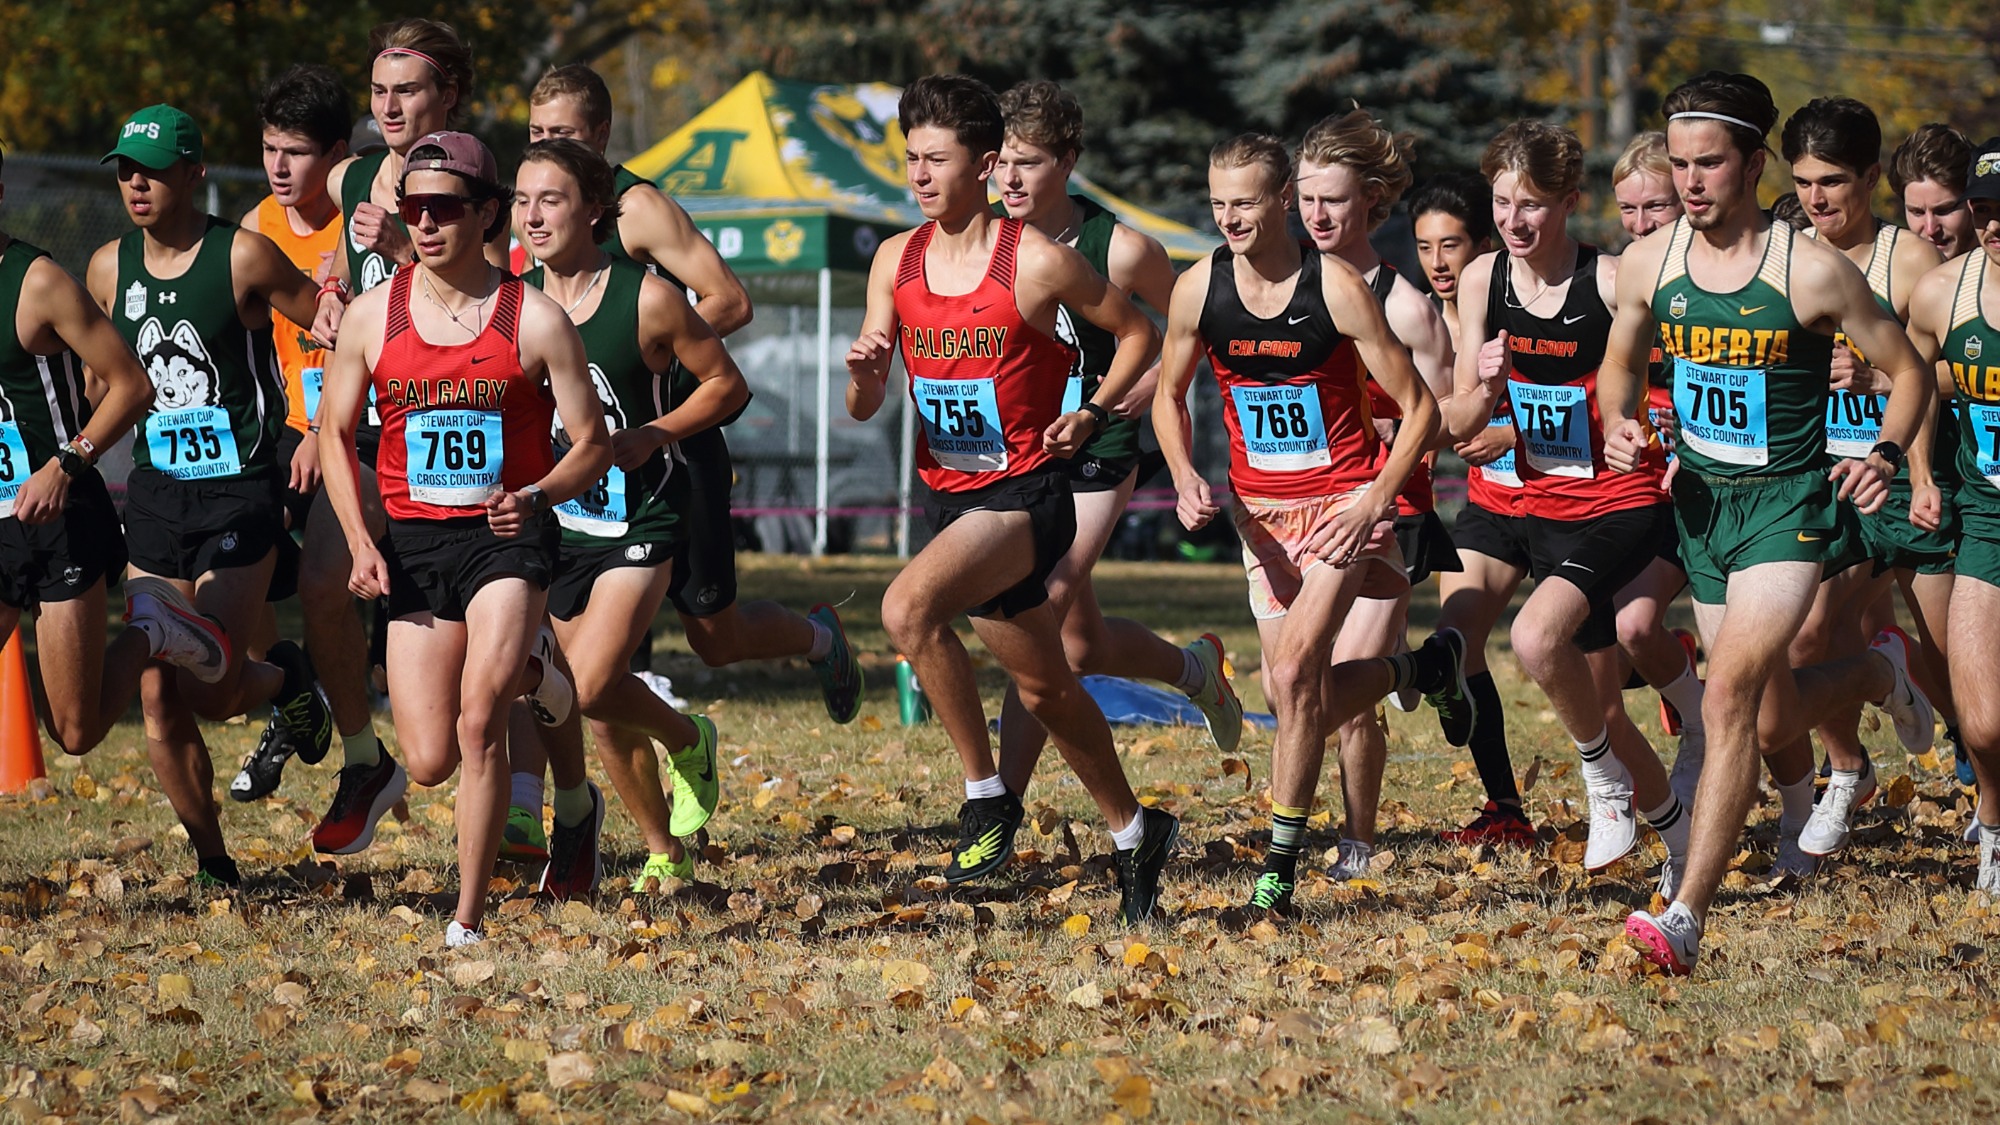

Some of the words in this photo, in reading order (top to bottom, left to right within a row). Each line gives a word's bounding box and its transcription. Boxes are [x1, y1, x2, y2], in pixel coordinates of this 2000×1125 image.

[1229, 339, 1302, 358] CALGARY
[1508, 335, 1578, 357] CALGARY
[1660, 322, 1789, 366] ALBERTA
[1686, 366, 1727, 385] STEWART
[1729, 374, 1749, 387] CUP
[387, 378, 508, 409] CALGARY
[922, 383, 959, 397] STEWART
[961, 384, 979, 396] CUP
[1243, 389, 1283, 402] STEWART
[1285, 388, 1303, 400] CUP
[1517, 386, 1553, 401] STEWART
[1555, 389, 1572, 402] CUP
[1686, 382, 1748, 430] 705
[1828, 391, 1883, 427] 704
[157, 413, 195, 427] STEWART
[197, 410, 214, 423] CUP
[420, 414, 465, 428] STEWART
[467, 414, 486, 427] CUP
[926, 398, 985, 438] 755
[1247, 402, 1309, 440] 768
[1520, 401, 1572, 442] 767
[1712, 429, 1756, 446] COUNTRY
[1825, 427, 1852, 439] CROSS
[1854, 429, 1880, 440] COUNT
[160, 425, 222, 465] 735
[421, 429, 487, 471] 769
[955, 440, 994, 452] COUNTRY
[1251, 440, 1277, 453] CROSS
[1279, 438, 1318, 452] COUNTRY
[1529, 442, 1546, 455] OSS
[1546, 444, 1583, 458] COUNTRY
[192, 461, 231, 477] COUNTRY
[1984, 464, 2000, 476] CRO
[416, 473, 448, 486] CROSS
[449, 472, 495, 486] COUNTRY
[558, 503, 579, 515] OSS
[580, 505, 618, 520] COUNTRY
